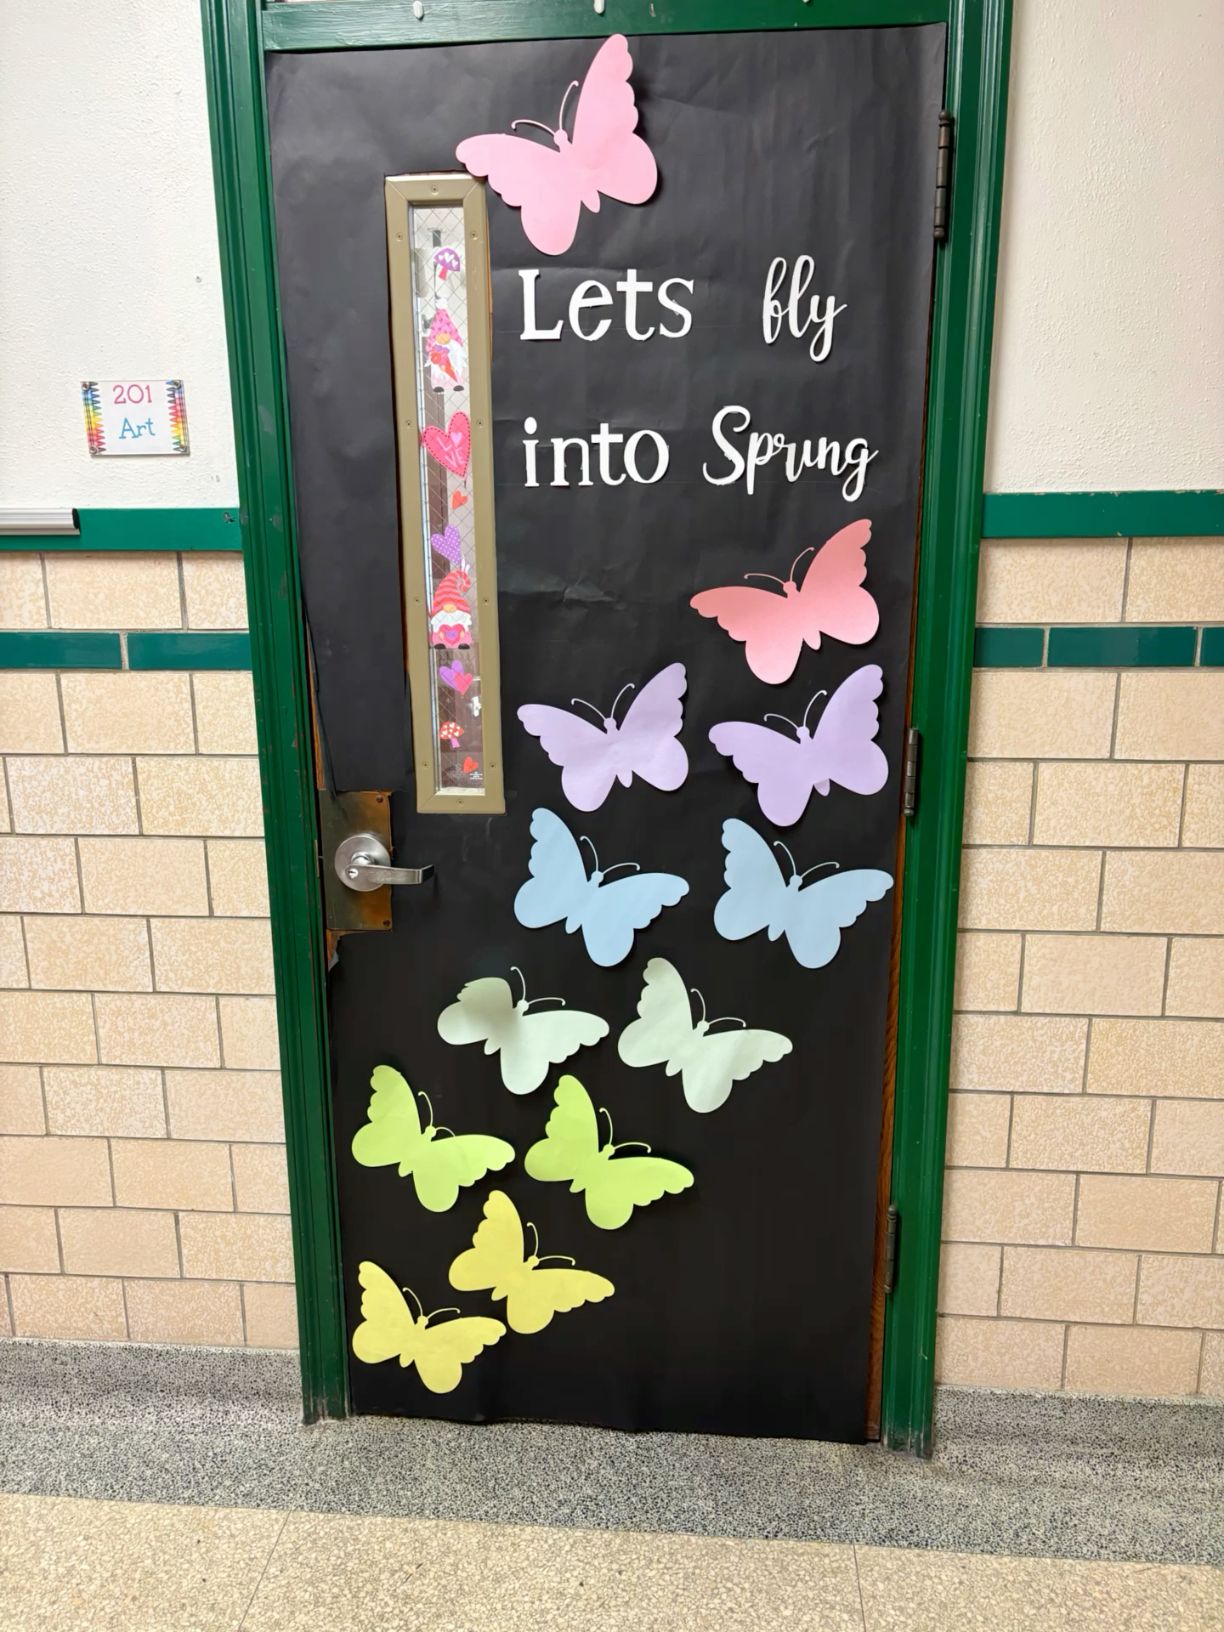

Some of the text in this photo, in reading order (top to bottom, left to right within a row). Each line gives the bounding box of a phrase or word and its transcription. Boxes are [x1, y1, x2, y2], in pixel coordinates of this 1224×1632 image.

[518, 254, 848, 362] Lets fly
[112, 383, 152, 405] 201
[118, 417, 156, 440] Art
[522, 416, 670, 488] into
